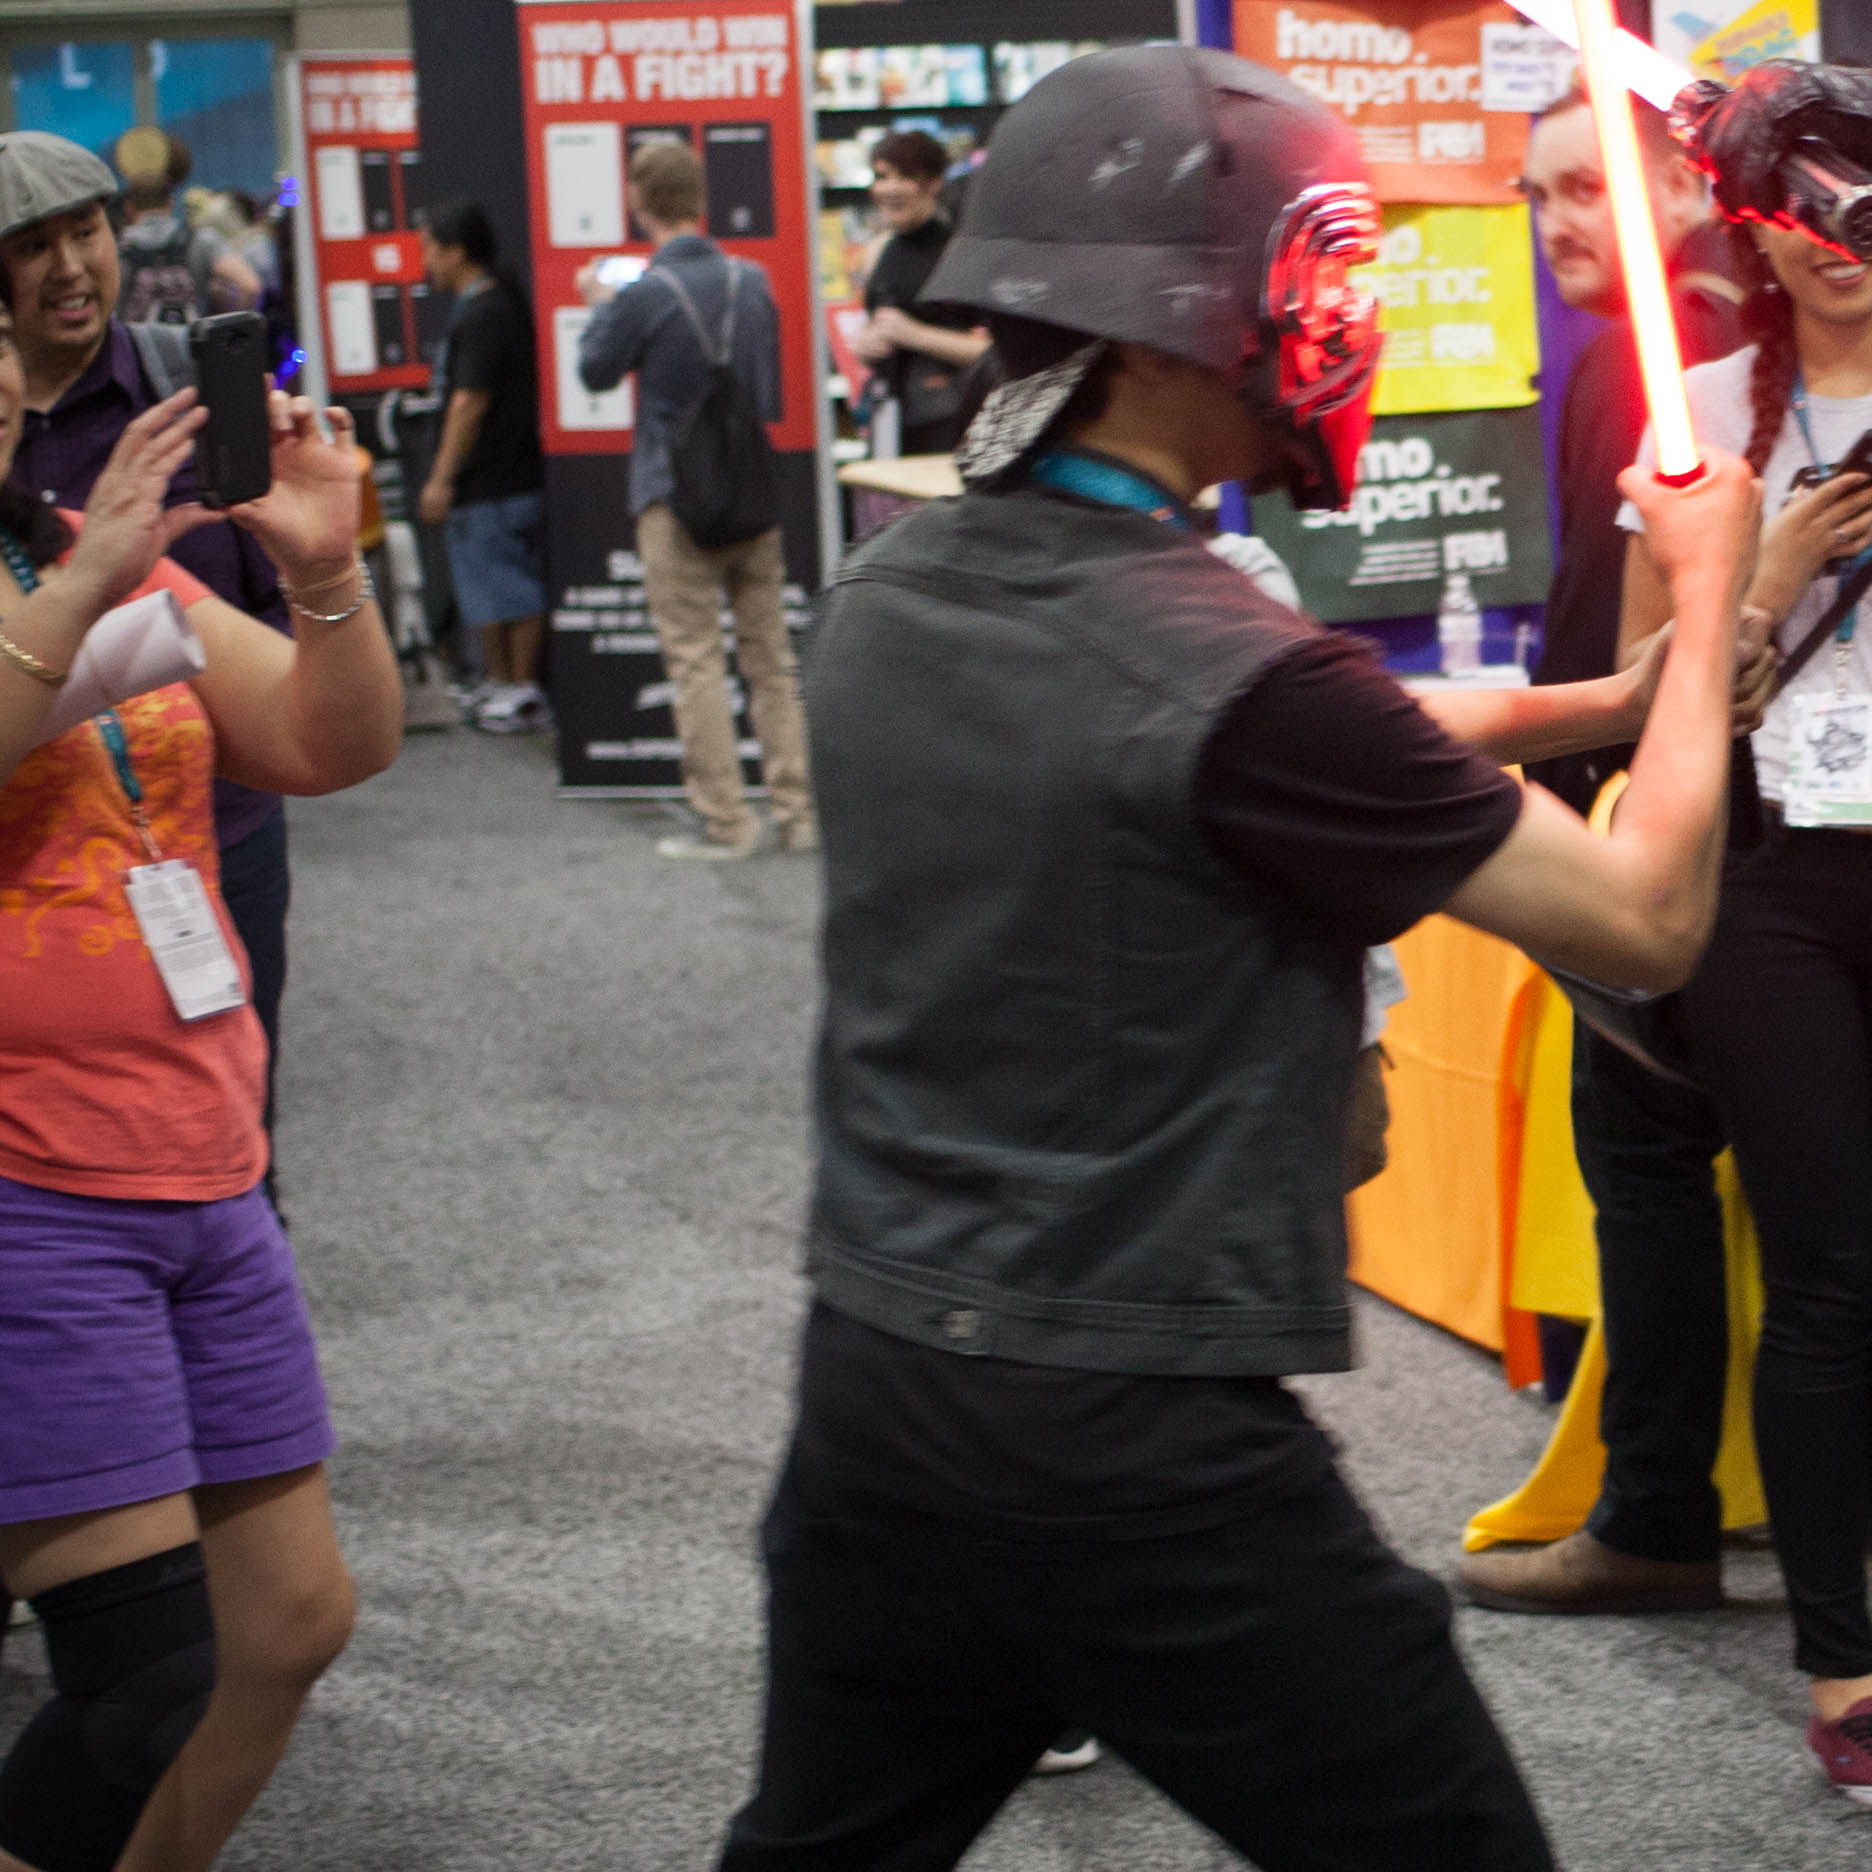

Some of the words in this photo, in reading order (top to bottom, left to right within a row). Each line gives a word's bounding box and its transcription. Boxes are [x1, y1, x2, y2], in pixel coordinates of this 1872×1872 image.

[1276, 9, 1430, 64] homo.
[533, 57, 584, 104] IN
[593, 56, 632, 103] A
[635, 51, 790, 102] FIGHT?
